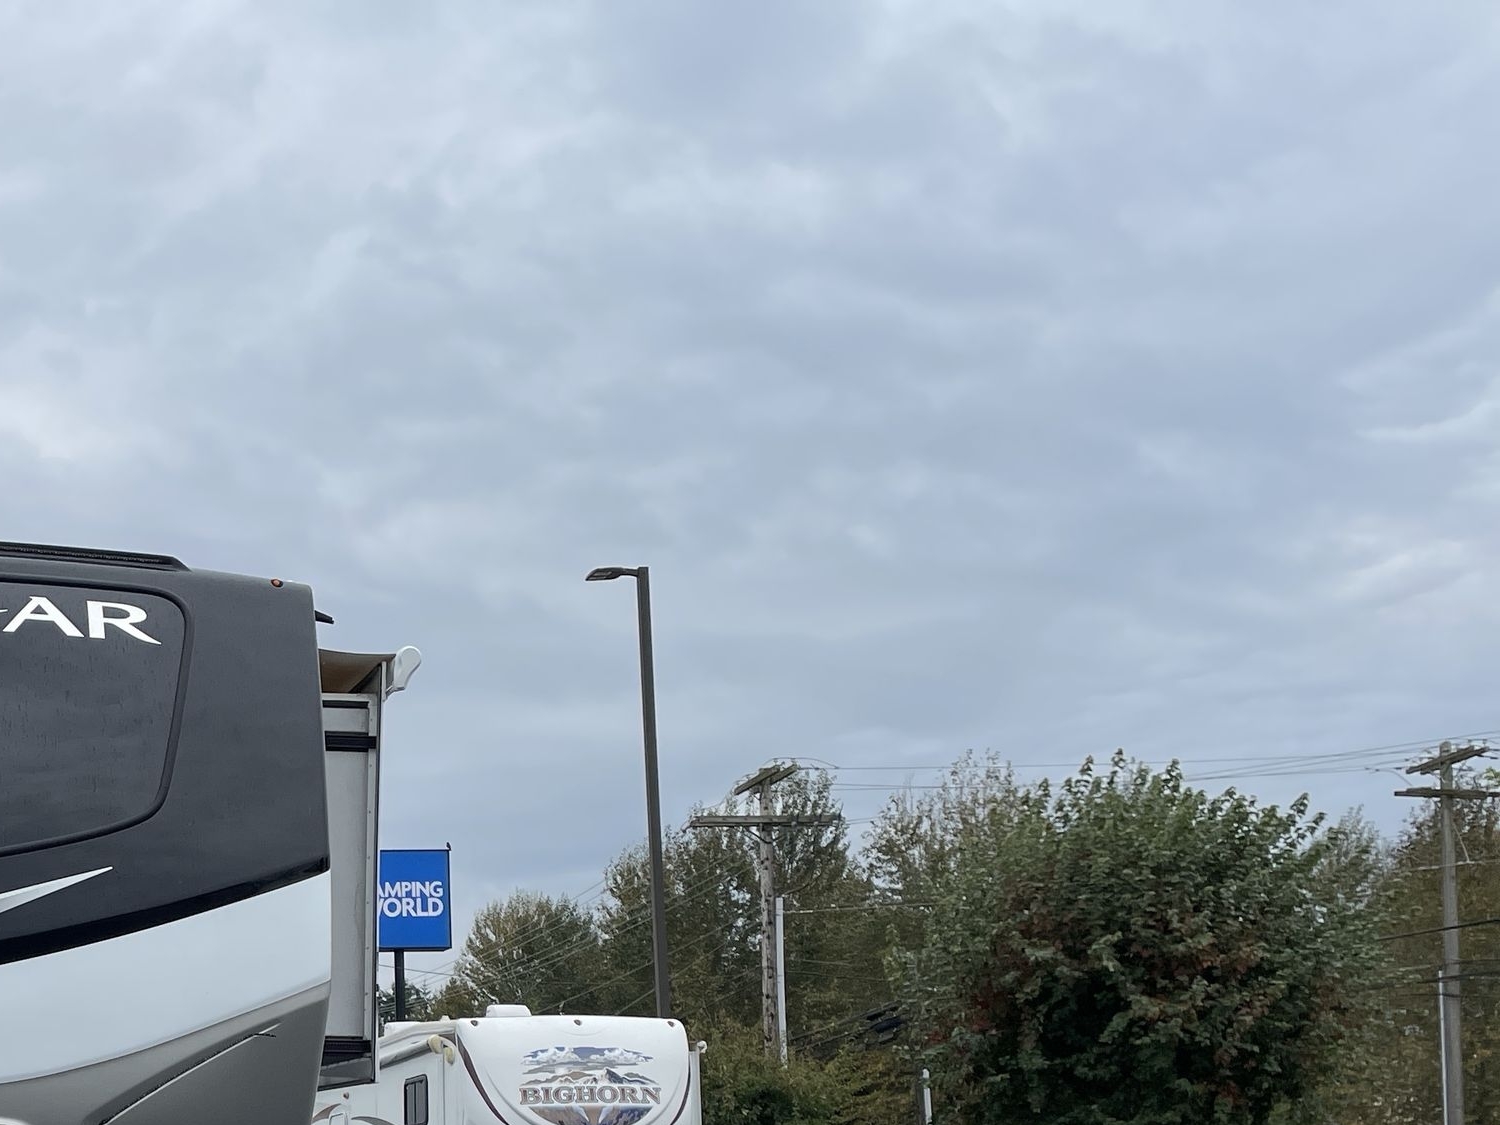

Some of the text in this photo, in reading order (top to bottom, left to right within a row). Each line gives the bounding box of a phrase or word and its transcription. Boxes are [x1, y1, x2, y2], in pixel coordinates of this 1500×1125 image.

[377, 881, 444, 898] AMPING
[378, 898, 444, 917] ORLD
[519, 1086, 661, 1104] BIGHORN
